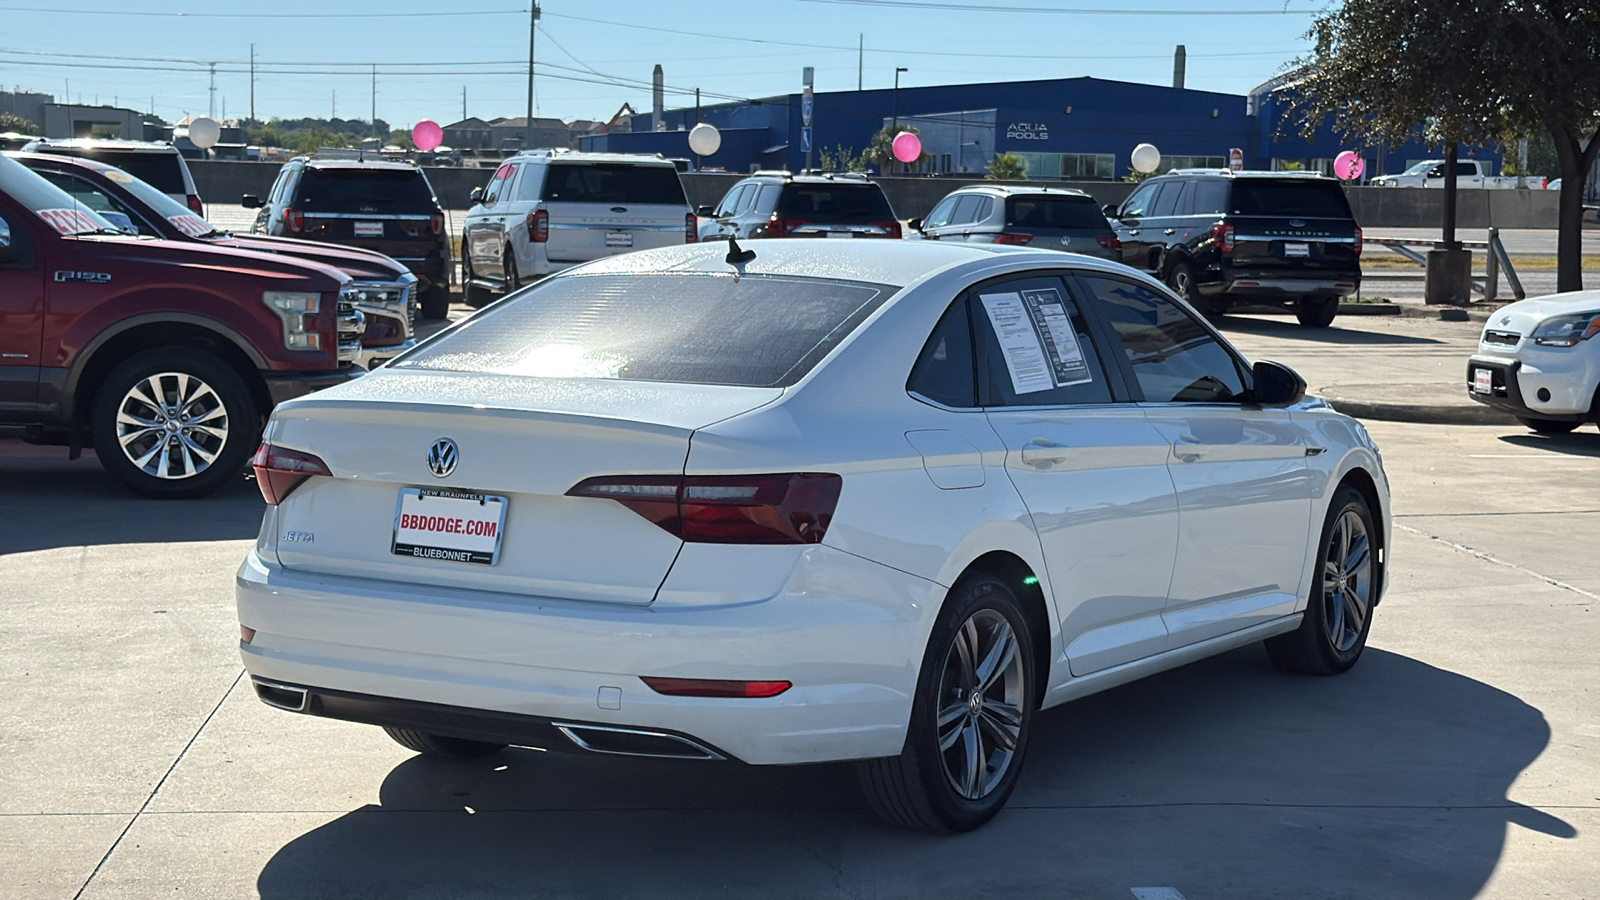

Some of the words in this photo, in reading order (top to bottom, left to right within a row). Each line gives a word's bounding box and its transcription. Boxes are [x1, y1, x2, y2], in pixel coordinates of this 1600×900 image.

[1007, 123, 1048, 132] AQUA
[1006, 132, 1048, 140] POOLS
[421, 489, 438, 497] NEW
[440, 491, 484, 501] BRAUNFELS
[400, 513, 497, 538] BBDODGE.COM
[283, 531, 315, 543] JETTA
[413, 547, 472, 562] BLUEBONNET
